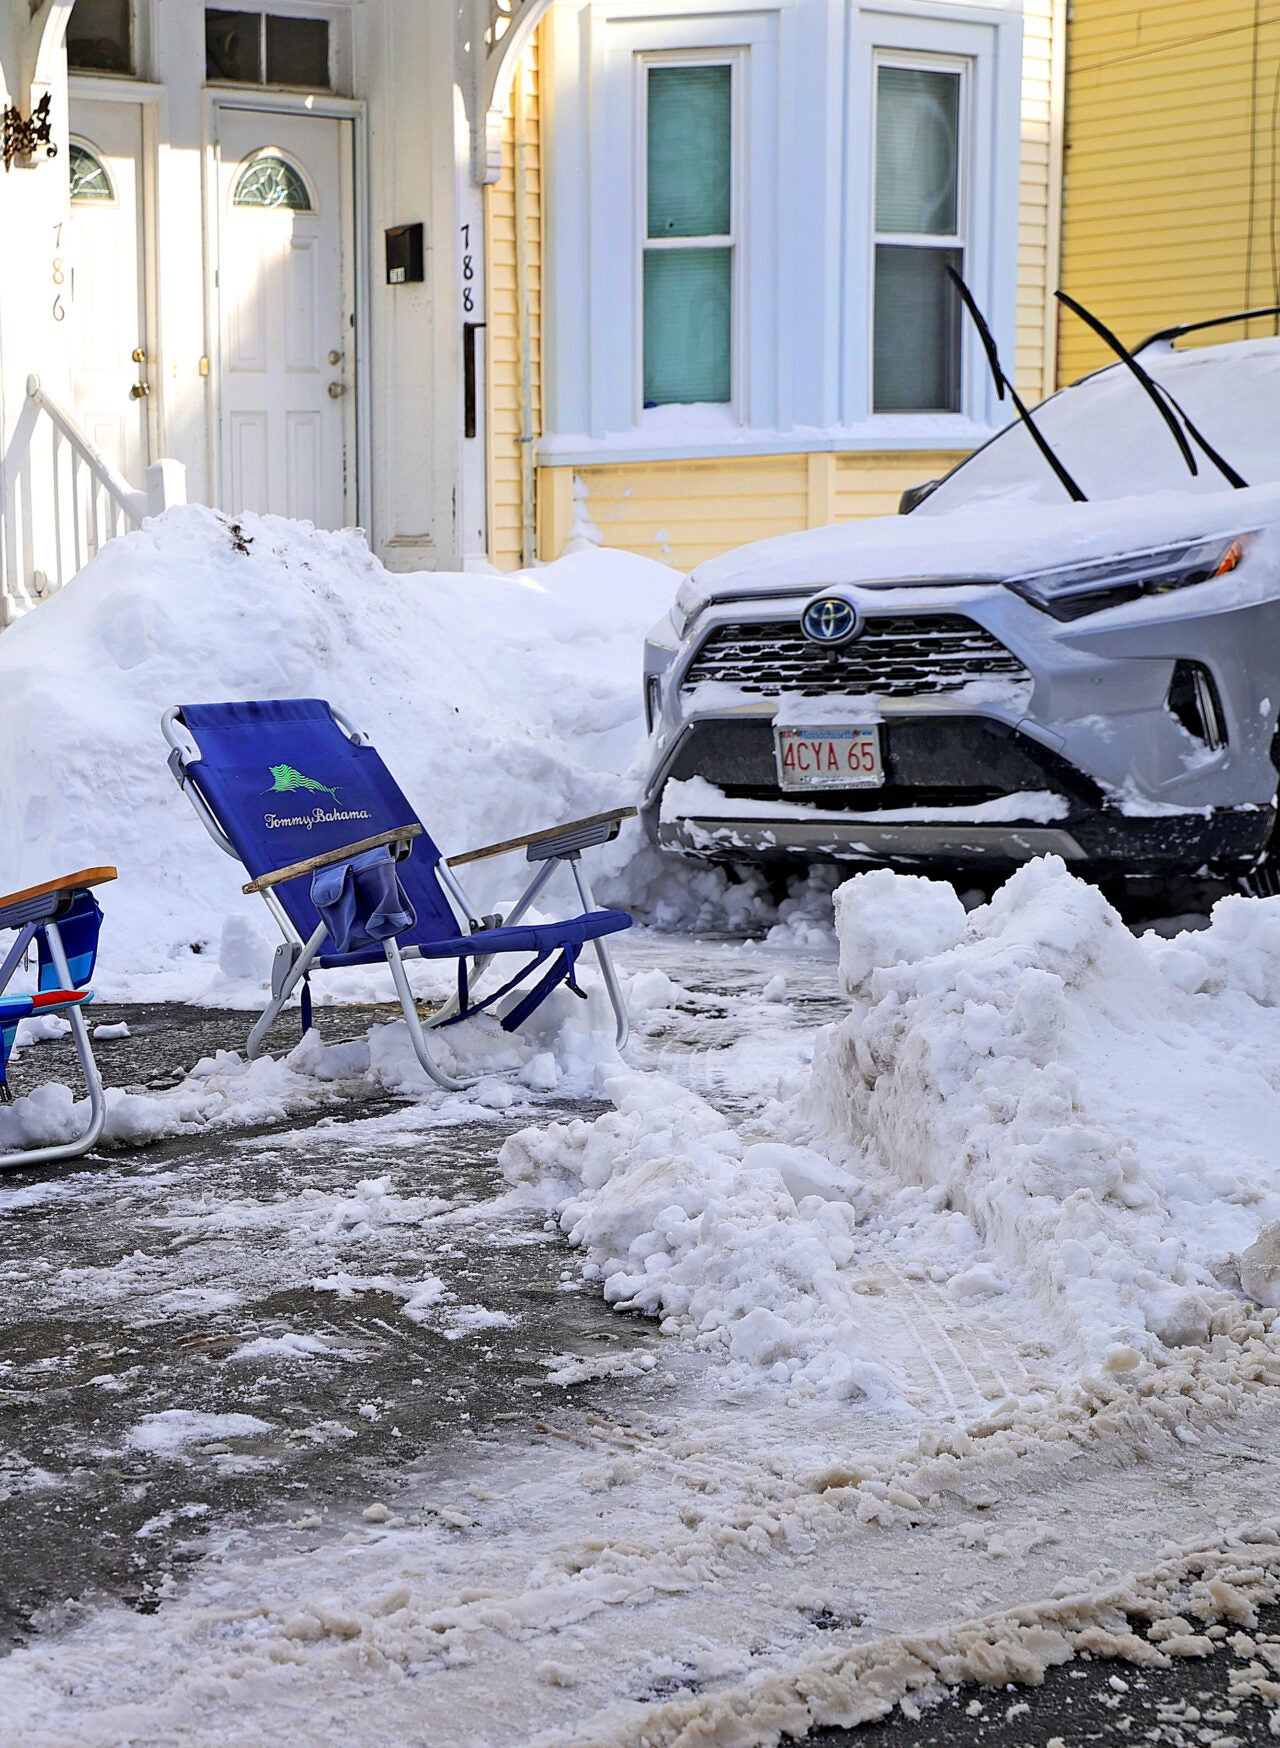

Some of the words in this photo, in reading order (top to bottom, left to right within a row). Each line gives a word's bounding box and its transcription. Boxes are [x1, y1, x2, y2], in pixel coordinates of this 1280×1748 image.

[52, 221, 65, 322] 786
[460, 223, 474, 312] 788
[783, 741, 840, 771] 4CYA
[847, 741, 875, 772] 65
